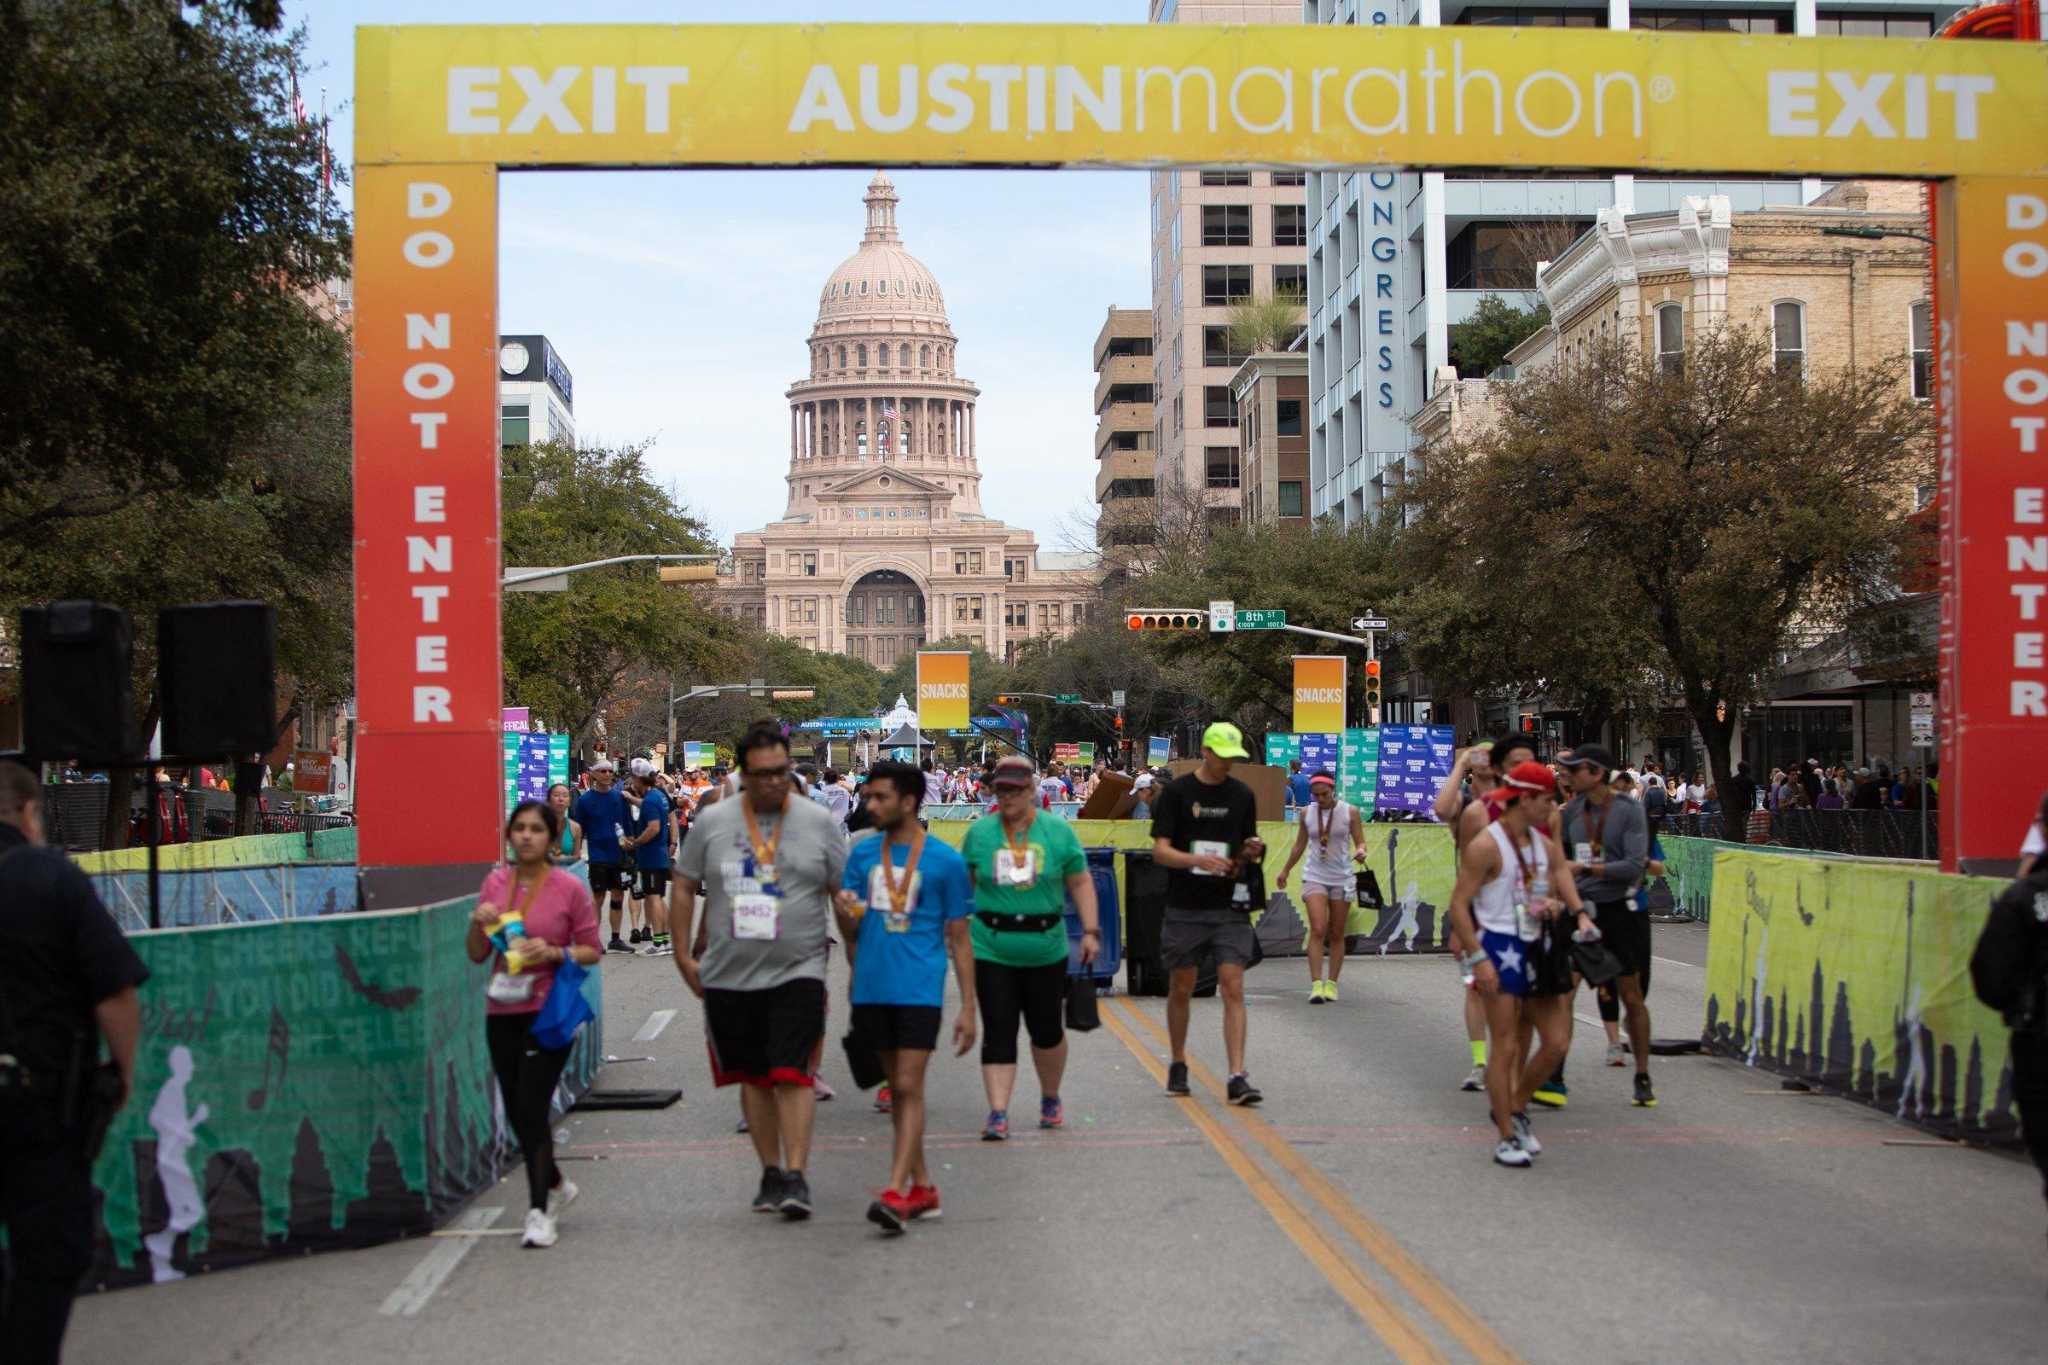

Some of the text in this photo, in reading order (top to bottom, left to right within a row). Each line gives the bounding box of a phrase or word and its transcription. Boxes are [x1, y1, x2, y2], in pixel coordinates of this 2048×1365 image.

[447, 66, 689, 134] EXIT
[1767, 70, 1996, 141] EXIT
[1370, 171, 1397, 408] ONGRESS
[403, 182, 455, 723] DO NOT ENTER
[2002, 194, 2048, 717] DO NOT ENTER
[1246, 612, 1263, 622] 8th
[920, 683, 968, 699] SNACKS
[1295, 687, 1342, 704] SNACKS
